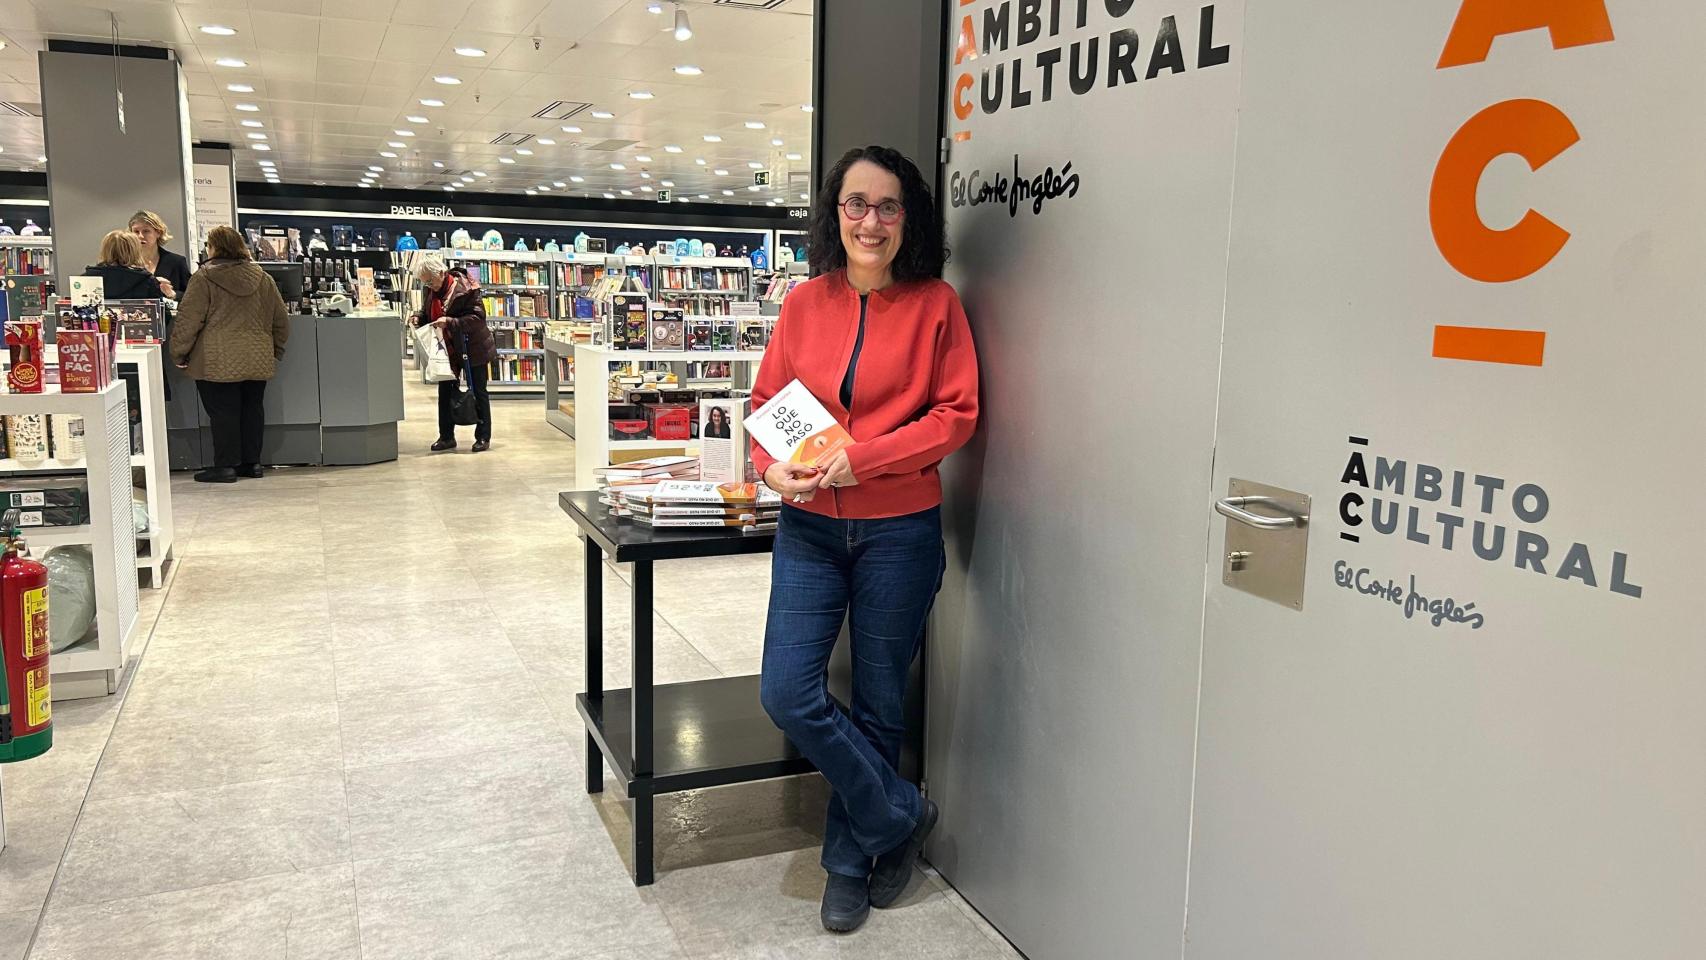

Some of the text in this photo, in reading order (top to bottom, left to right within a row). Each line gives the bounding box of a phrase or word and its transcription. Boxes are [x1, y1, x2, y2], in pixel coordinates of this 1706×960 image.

[953, 5, 1230, 120] CULTURAL
[950, 153, 1080, 218] El Corte Inglés
[391, 205, 454, 216] PAPELERÍA
[789, 208, 808, 217] caja
[60, 343, 90, 354] GUA
[70, 354, 89, 362] TA
[64, 361, 92, 372] FAC
[772, 406, 787, 420] LO
[775, 409, 799, 430] QUE
[784, 420, 802, 436] NO
[1339, 491, 1643, 599] CULTURAL
[1334, 560, 1484, 629] El Corte Inglés
